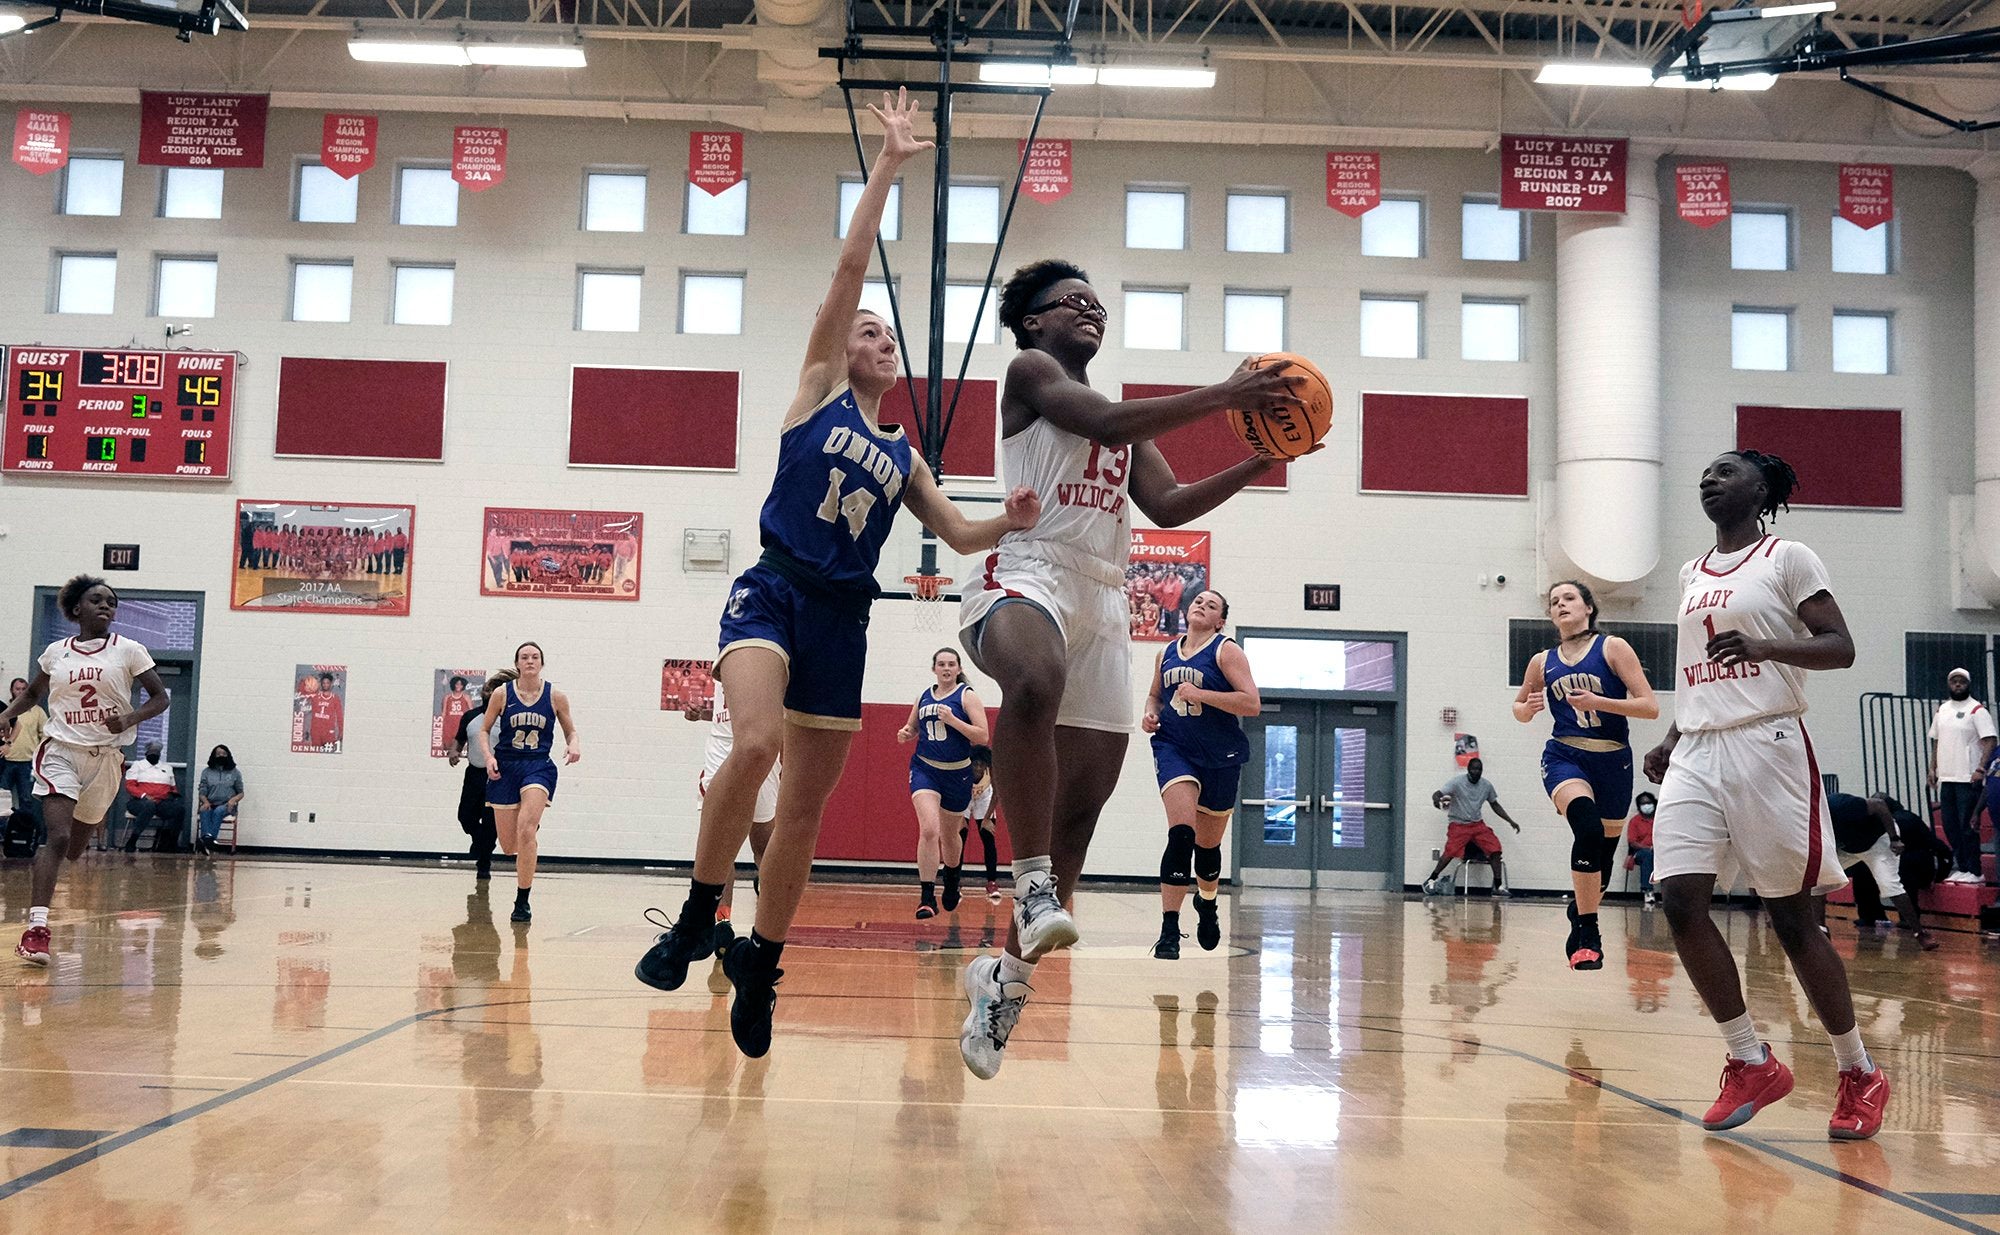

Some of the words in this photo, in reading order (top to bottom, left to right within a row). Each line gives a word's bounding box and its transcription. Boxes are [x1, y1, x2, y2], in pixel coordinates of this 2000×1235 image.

[167, 97, 197, 106] LUCY
[203, 99, 240, 107] LANEY
[30, 112, 59, 123] BOYS
[175, 107, 232, 117] FOOTBALL
[27, 121, 60, 133] 4AAAA
[167, 117, 206, 126] REGION
[212, 118, 218, 126] 7
[223, 119, 239, 127] AA
[338, 118, 365, 127] BOYS
[172, 127, 234, 136] CHAMPIONS
[335, 126, 366, 137] 4AAAA
[462, 129, 500, 138] BOYS
[28, 133, 56, 143] 1982
[167, 136, 237, 146] SEMI-FINALS
[335, 138, 363, 146] REGION
[457, 137, 503, 146] TRACK
[702, 135, 731, 143] BOYS
[161, 145, 208, 155] GEORGIA
[213, 147, 243, 156] DOME
[328, 145, 370, 155] CHAMPIONS
[701, 142, 733, 153] 3AA
[1514, 140, 1555, 152] LUCY
[1562, 142, 1614, 155] LANEY
[190, 156, 212, 165] 2004
[334, 153, 362, 163] 1985
[463, 156, 496, 164] REGION
[702, 153, 731, 162] 2010
[1029, 158, 1061, 168] 2010
[1334, 155, 1373, 163] BOYS
[1519, 154, 1564, 166] GIRLS
[1571, 156, 1608, 168] GOLF
[456, 162, 502, 172] CHAMPIONS
[1330, 162, 1376, 170] TRACK
[1842, 166, 1889, 177] FOOTBALL
[465, 170, 492, 181] 3AA
[1022, 175, 1070, 184] CHAMPIONS
[1338, 171, 1369, 180] 2011
[1513, 167, 1568, 180] REGION
[1574, 170, 1584, 181] 3
[1590, 171, 1614, 182] AA
[1336, 181, 1371, 189] REGION
[1686, 181, 1719, 191] 3AA
[1849, 177, 1883, 187] 3AA
[1032, 183, 1060, 193] 3AA
[1330, 188, 1377, 197] CHAMPIONS
[1519, 181, 1608, 195] RUNNER-UP
[1341, 196, 1368, 206] 3AA
[1545, 195, 1582, 208] 2007
[1686, 192, 1722, 202] 2011
[1681, 209, 1705, 217] FINAL
[1706, 209, 1728, 217] FOUR
[1852, 204, 1882, 216] 2011
[17, 352, 70, 366] GUEST
[177, 357, 224, 371] HOME
[101, 354, 160, 384] 3:08
[26, 371, 63, 400] 34
[184, 376, 220, 406] 45
[77, 400, 124, 411] PERIOD
[131, 394, 147, 419] 3
[23, 424, 55, 434] FOULS
[83, 426, 151, 437] PLAYER-FOUL
[181, 430, 212, 439] FOULS
[41, 436, 48, 459] 1
[101, 438, 116, 461] 0
[199, 442, 206, 464] 1
[18, 460, 54, 470] POINTS
[82, 463, 117, 472] MATCH
[822, 426, 903, 506] UNION
[1083, 440, 1129, 487] 13
[176, 465, 212, 475] POINTS
[816, 467, 877, 542] 14
[1057, 483, 1125, 520] WILDCA
[110, 550, 132, 564] EXIT
[300, 583, 325, 593] 2017
[327, 584, 342, 593] AA
[277, 594, 301, 604] State
[302, 595, 363, 606] Champions
[1312, 590, 1334, 604] EXIT
[1685, 590, 1733, 616] LADY
[1702, 614, 1716, 640] 1
[664, 659, 692, 669] 2022
[69, 667, 103, 685] LADY
[1163, 666, 1204, 689] UNION
[1683, 660, 1760, 688] WILDCATS
[1551, 673, 1604, 701] UNION
[79, 684, 98, 709] 2
[510, 711, 547, 729] UNION
[293, 711, 304, 742] SENIOR
[432, 716, 443, 747] SENIOR
[926, 720, 948, 741] 10
[512, 730, 540, 750] 24
[292, 745, 324, 753] DENNIS
[323, 741, 342, 754] #1
[432, 749, 449, 757] FRY
